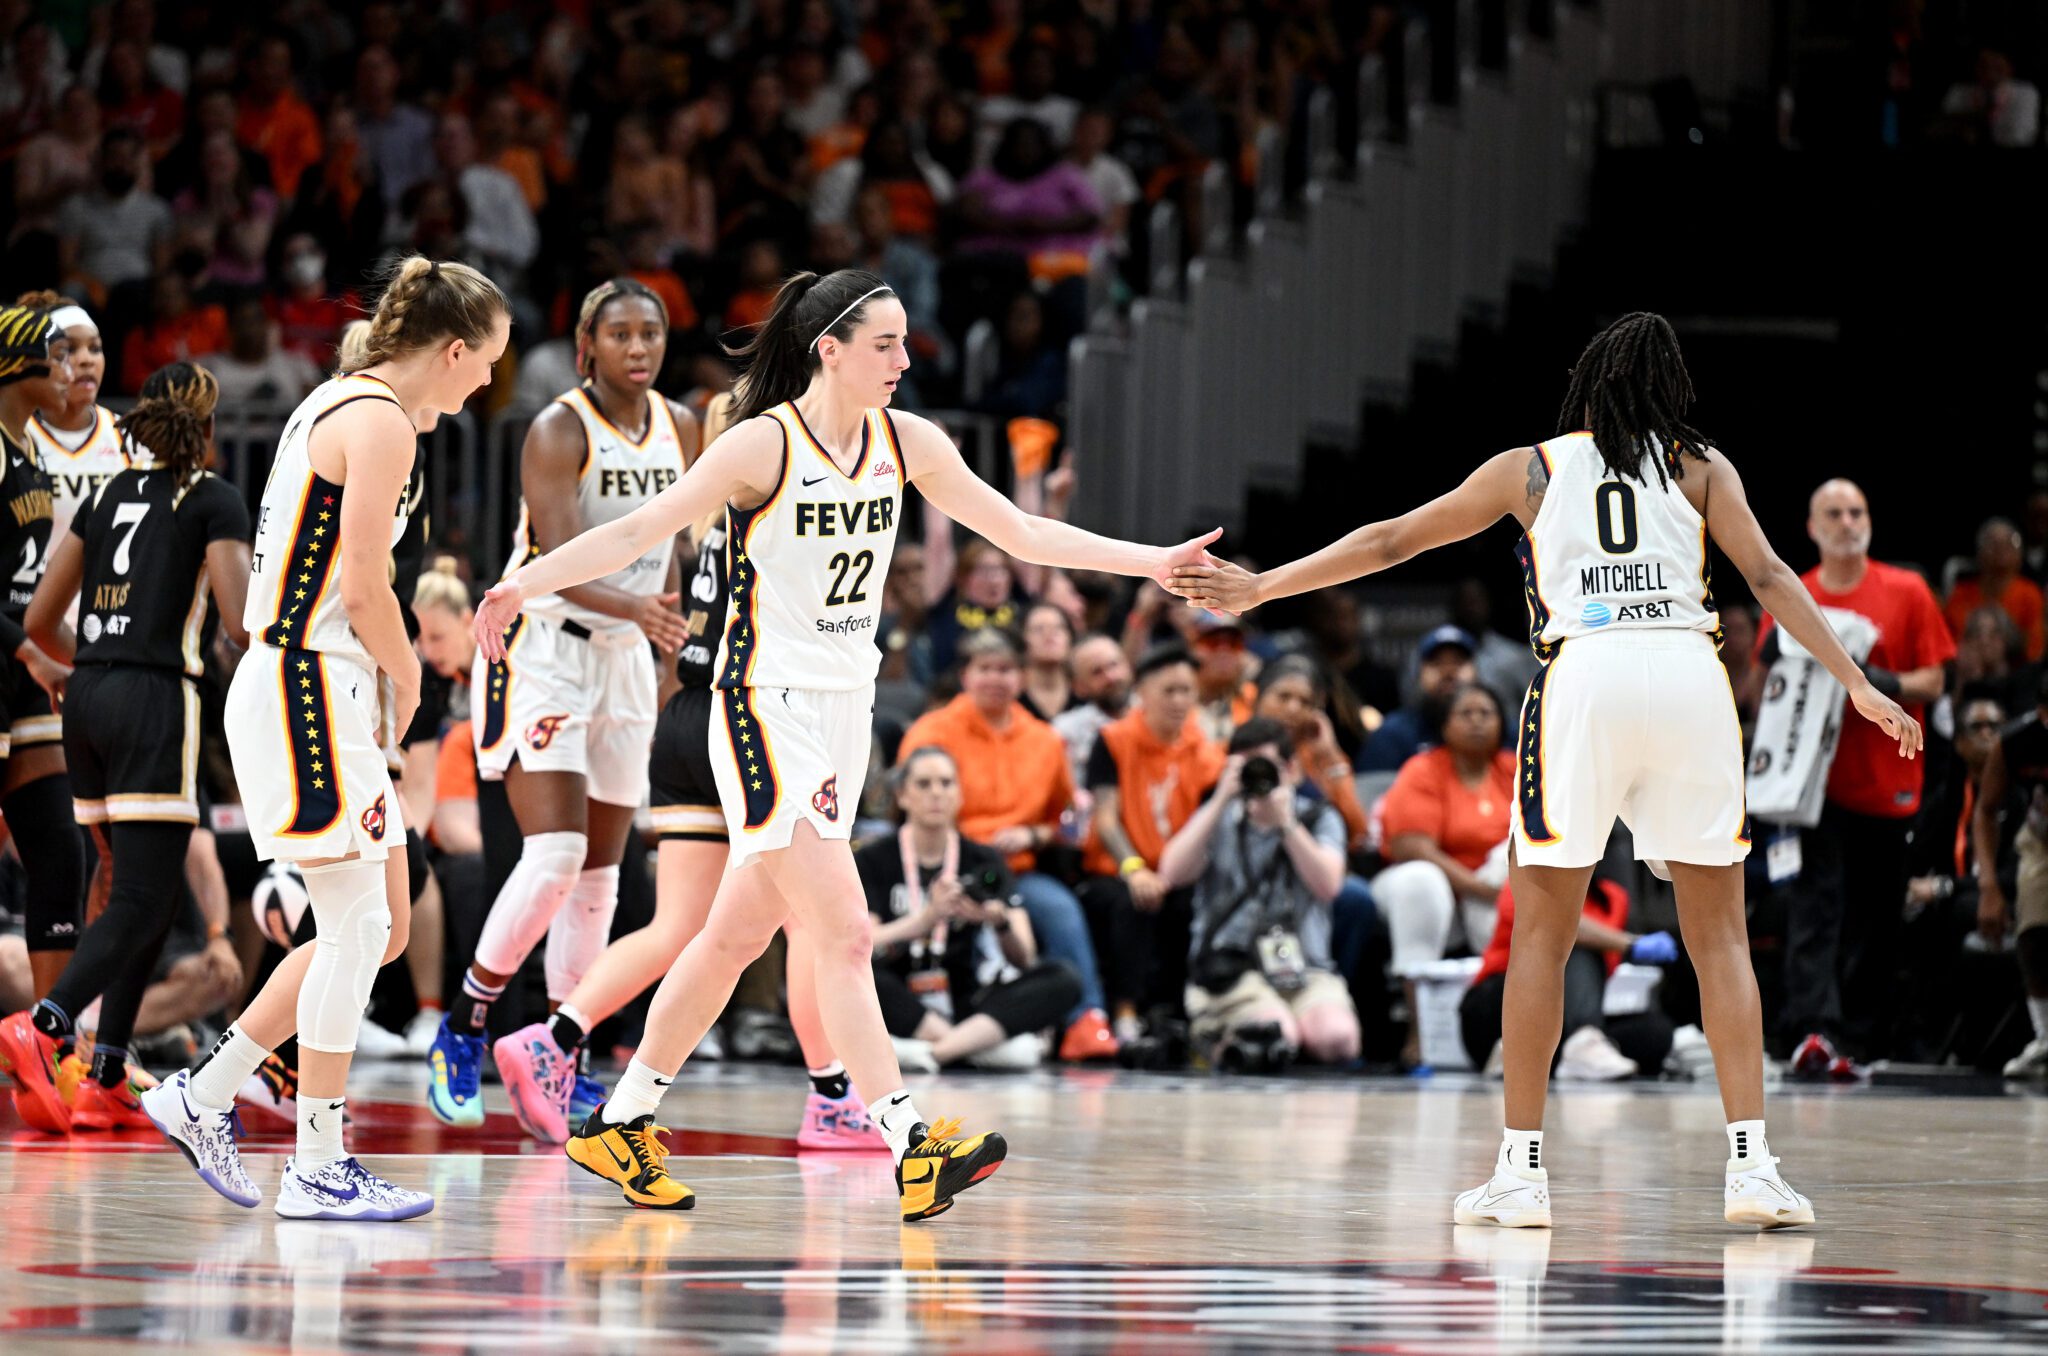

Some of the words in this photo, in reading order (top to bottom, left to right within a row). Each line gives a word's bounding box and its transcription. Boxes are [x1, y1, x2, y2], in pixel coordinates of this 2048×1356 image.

[873, 461, 896, 477] Lilly
[796, 496, 893, 536] FEVER
[1596, 481, 1638, 554] 0
[112, 503, 150, 575] 7
[826, 550, 874, 606] 22
[1581, 563, 1667, 595] MITCHELL
[1617, 600, 1672, 621] AT&T
